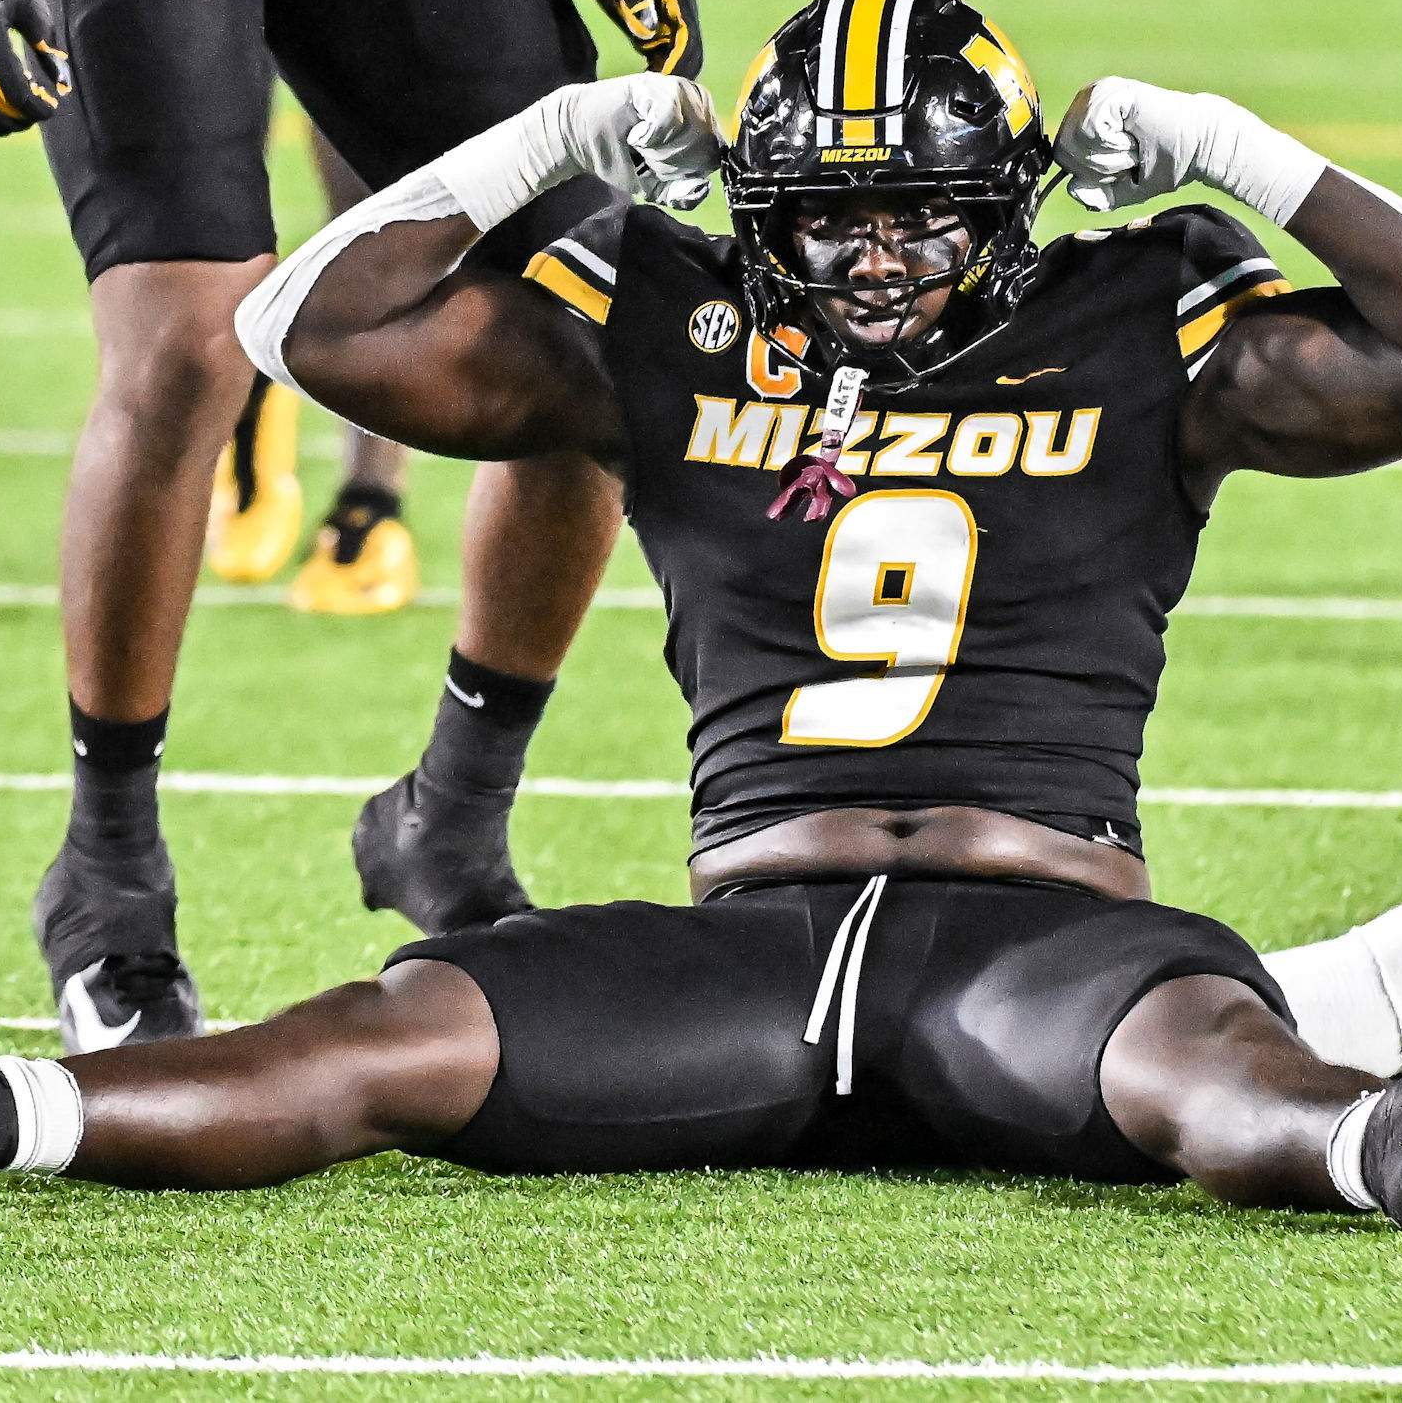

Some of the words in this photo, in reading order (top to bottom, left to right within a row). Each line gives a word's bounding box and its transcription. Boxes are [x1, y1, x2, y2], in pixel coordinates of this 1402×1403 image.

[820, 147, 891, 163] MIZZOU
[692, 303, 736, 349] SEC
[746, 323, 811, 399] C
[684, 394, 1102, 477] MIZZOU
[780, 488, 978, 747] 9
